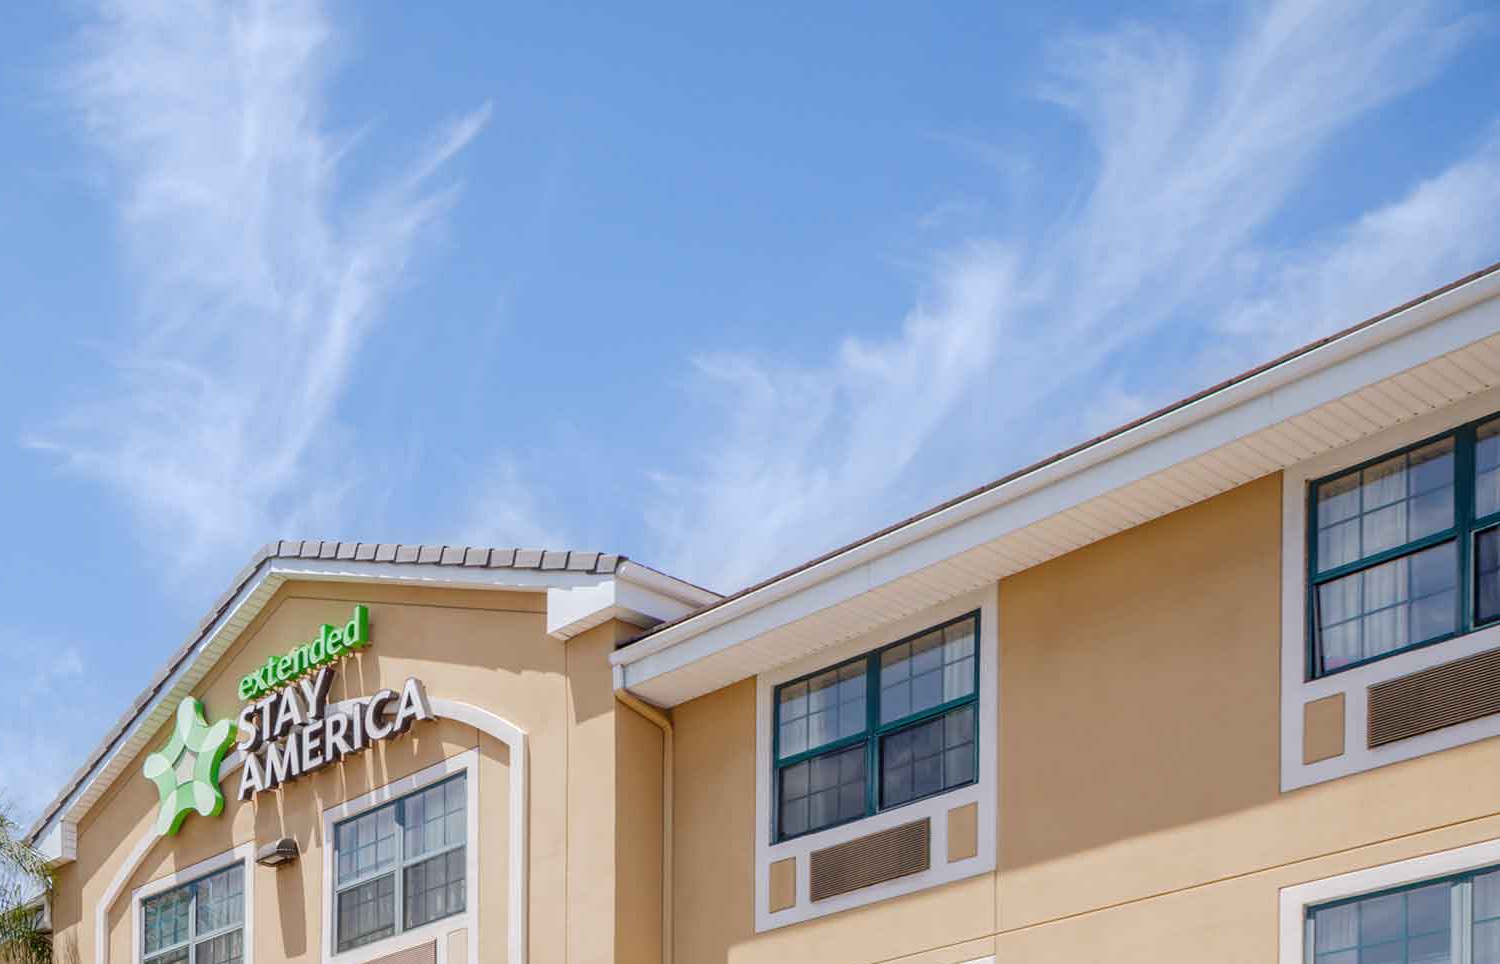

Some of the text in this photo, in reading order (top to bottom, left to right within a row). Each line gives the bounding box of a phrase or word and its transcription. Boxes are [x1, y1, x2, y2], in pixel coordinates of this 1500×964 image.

[237, 603, 369, 700] extended
[237, 666, 335, 752] STAY
[237, 676, 437, 801] AMERICA
